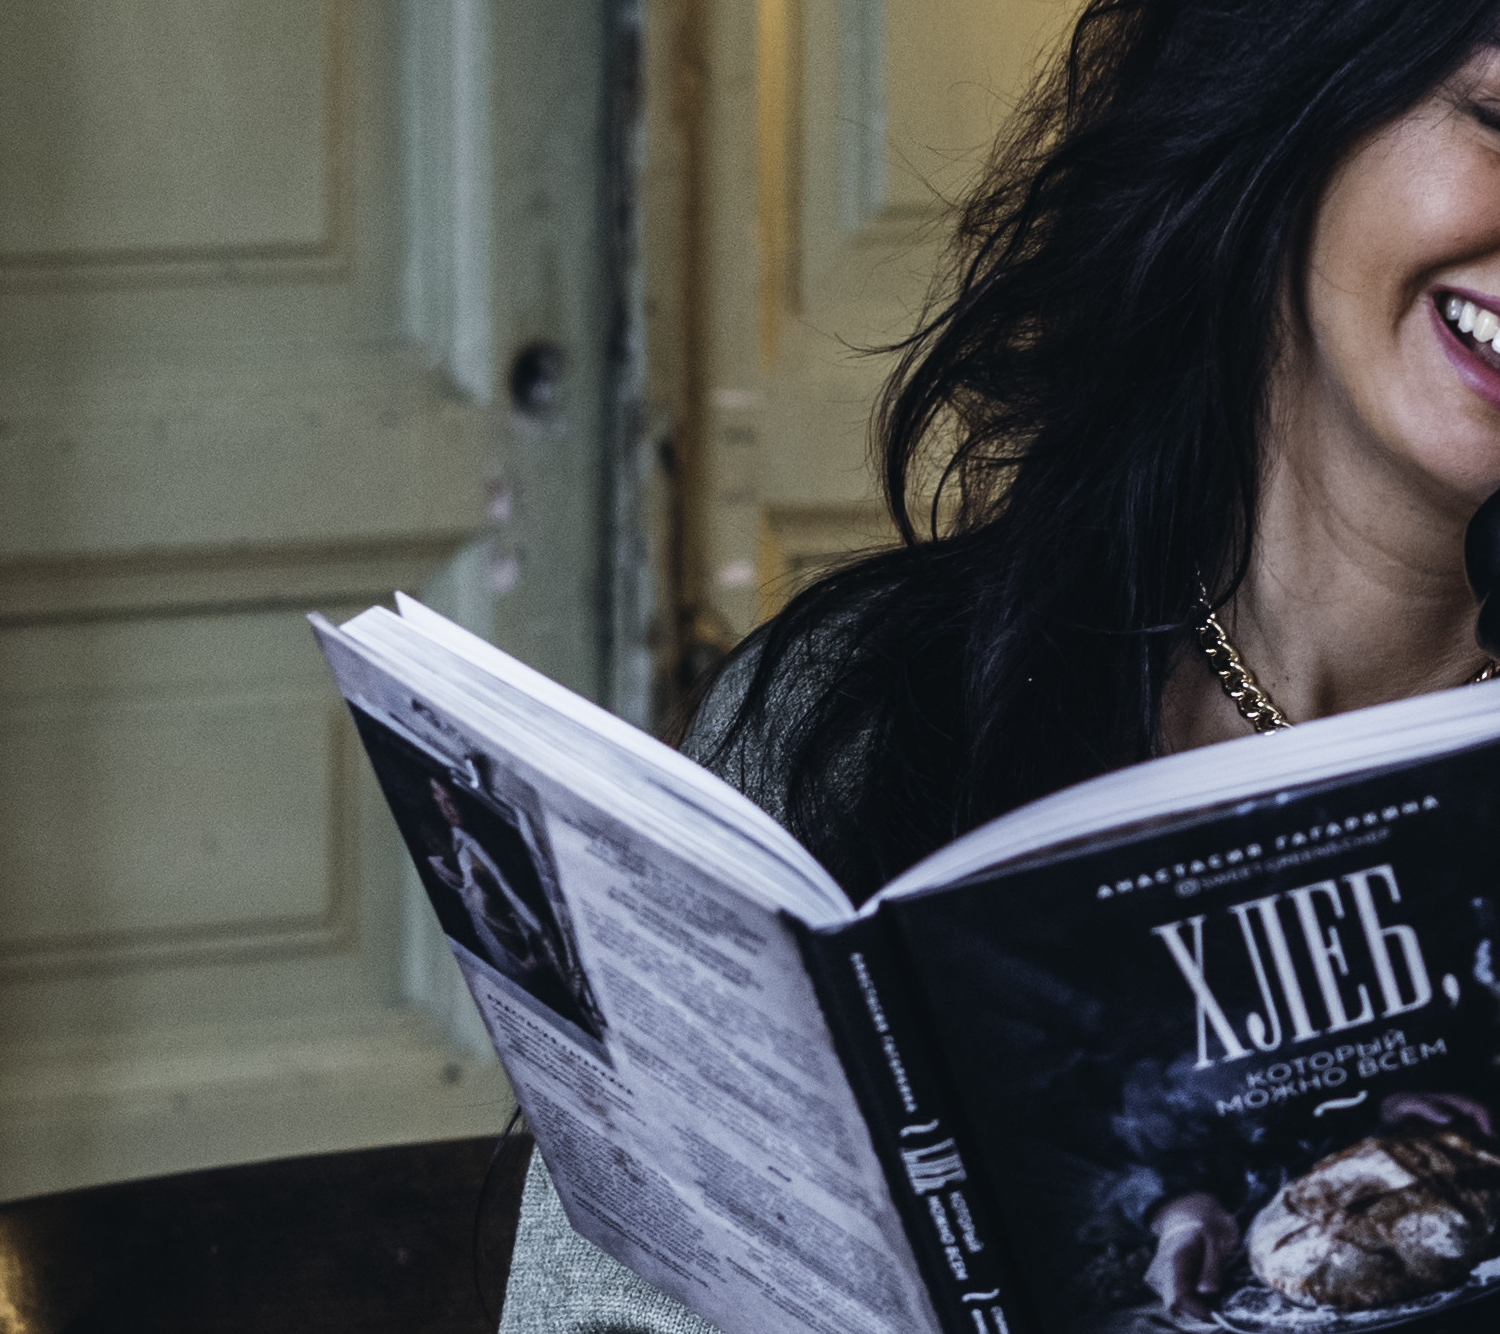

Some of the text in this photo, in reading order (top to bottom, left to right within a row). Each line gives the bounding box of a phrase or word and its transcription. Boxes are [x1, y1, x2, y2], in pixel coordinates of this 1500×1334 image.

[1150, 862, 1461, 1070] ХЛЕБ,
[1215, 1037, 1448, 1117] МОЖНО ВСЕМ
[1246, 1028, 1406, 1089] КОТОРЫЙ
